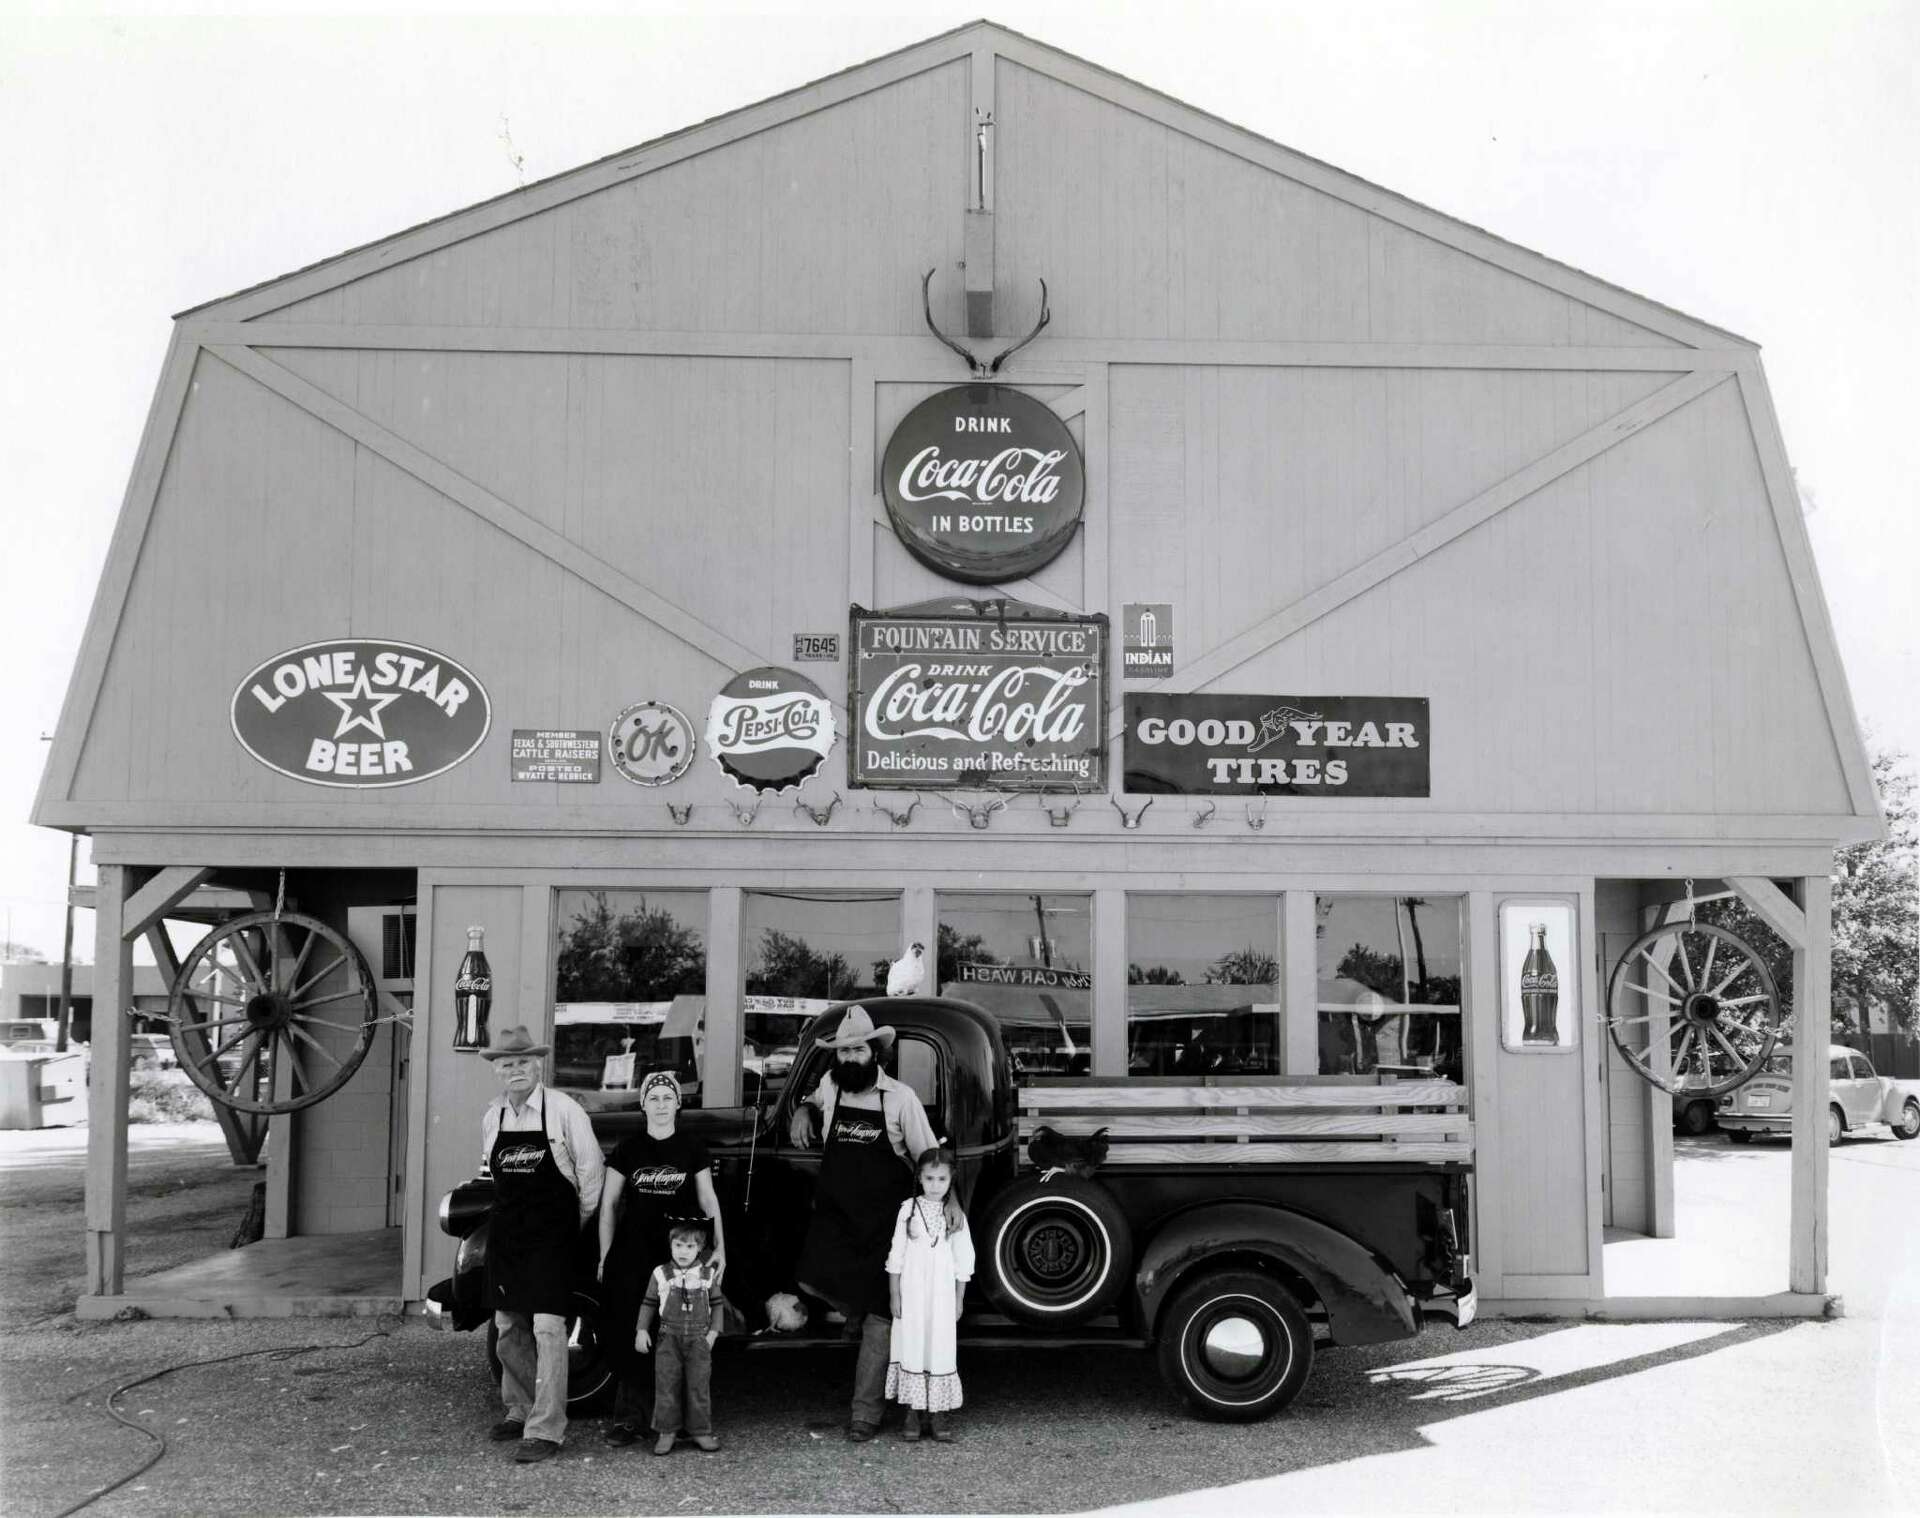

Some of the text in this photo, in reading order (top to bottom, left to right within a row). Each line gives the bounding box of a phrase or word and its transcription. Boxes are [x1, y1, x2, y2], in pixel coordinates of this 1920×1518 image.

[955, 416, 1012, 433] DRINK
[899, 445, 1068, 504] Coca-Cola
[932, 516, 1034, 533] IN BOTTLES
[804, 638, 836, 653] 7645
[872, 627, 1086, 653] FOUNTAIN SERVICE
[1125, 649, 1172, 665] INDIAN
[251, 651, 470, 717] LONE STAR
[927, 665, 995, 677] DRINK
[749, 680, 779, 689] DRINK
[865, 664, 1092, 744] Coca-Cola
[513, 739, 535, 748] TEXAS
[537, 739, 545, 748] &
[625, 719, 677, 762] OK
[1137, 718, 1420, 748] GOOD YEAR
[305, 737, 414, 776] BEER
[513, 749, 599, 760] CATTLE RAISERS
[867, 751, 1090, 777] Delicious and Refreshing
[1207, 758, 1349, 785] TIRES
